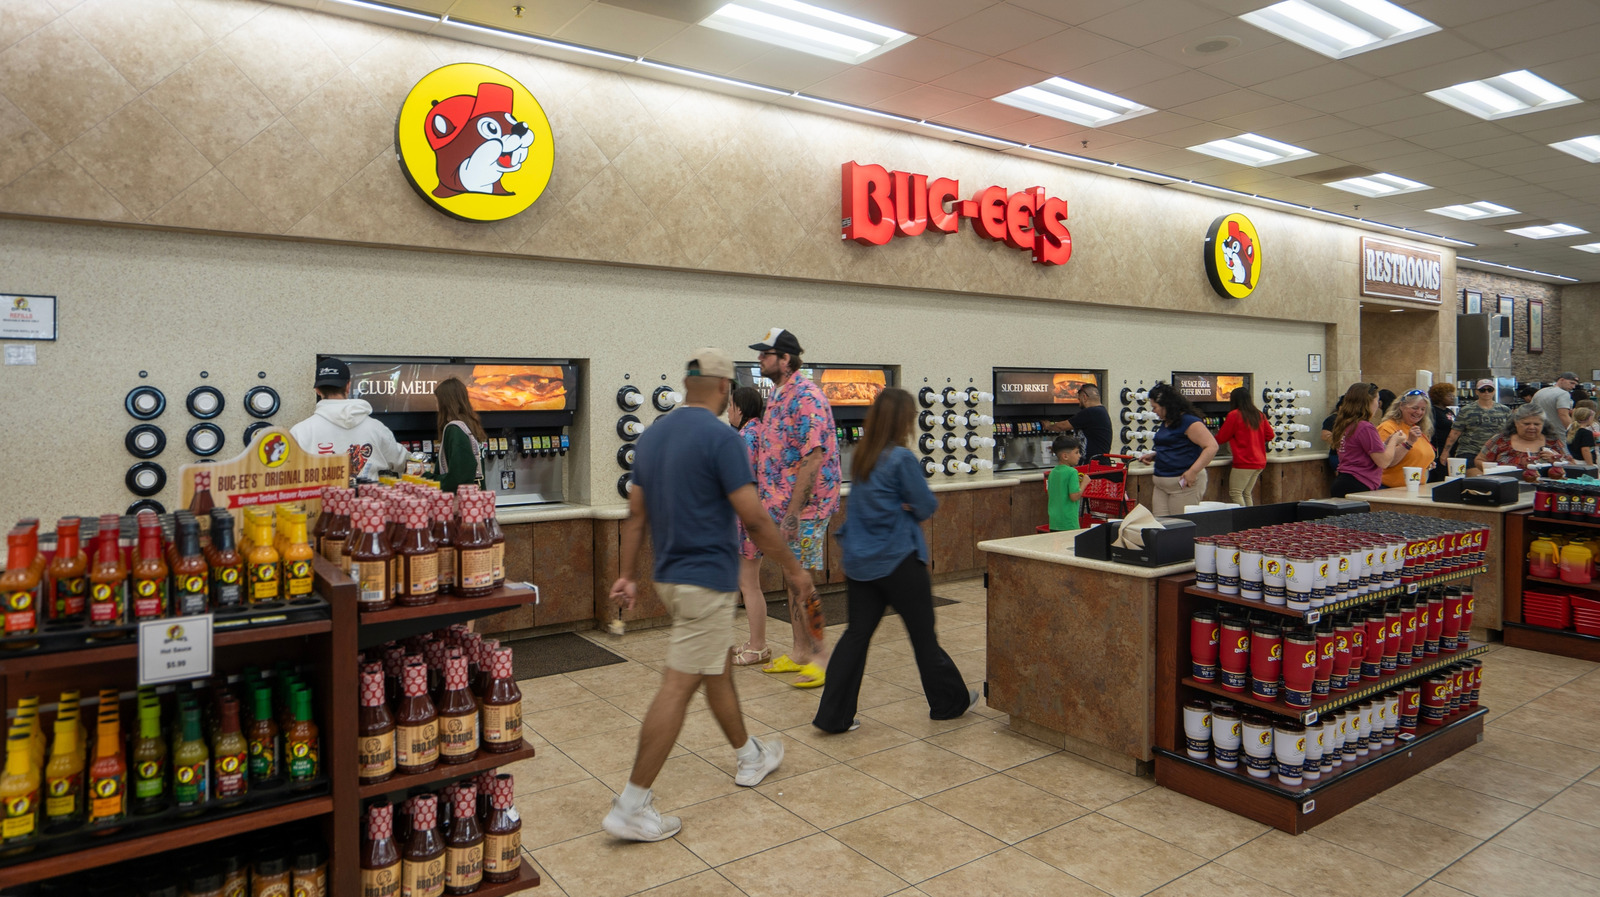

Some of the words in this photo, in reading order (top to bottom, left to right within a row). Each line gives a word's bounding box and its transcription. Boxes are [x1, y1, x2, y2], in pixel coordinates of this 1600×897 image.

[1366, 248, 1440, 291] RESTROOMS
[357, 380, 396, 395] CLUB
[400, 380, 438, 395] MELT
[1001, 384, 1023, 393] SLICED
[1024, 384, 1049, 393] BRISKET
[1181, 380, 1198, 388] SAUSAGE
[1181, 388, 1194, 396] CHEESE
[264, 470, 301, 487] ORIGINAL
[304, 468, 320, 483] BBQ
[322, 466, 345, 481] SAUCE
[238, 496, 259, 506] Beaver
[279, 491, 298, 500] Beaver
